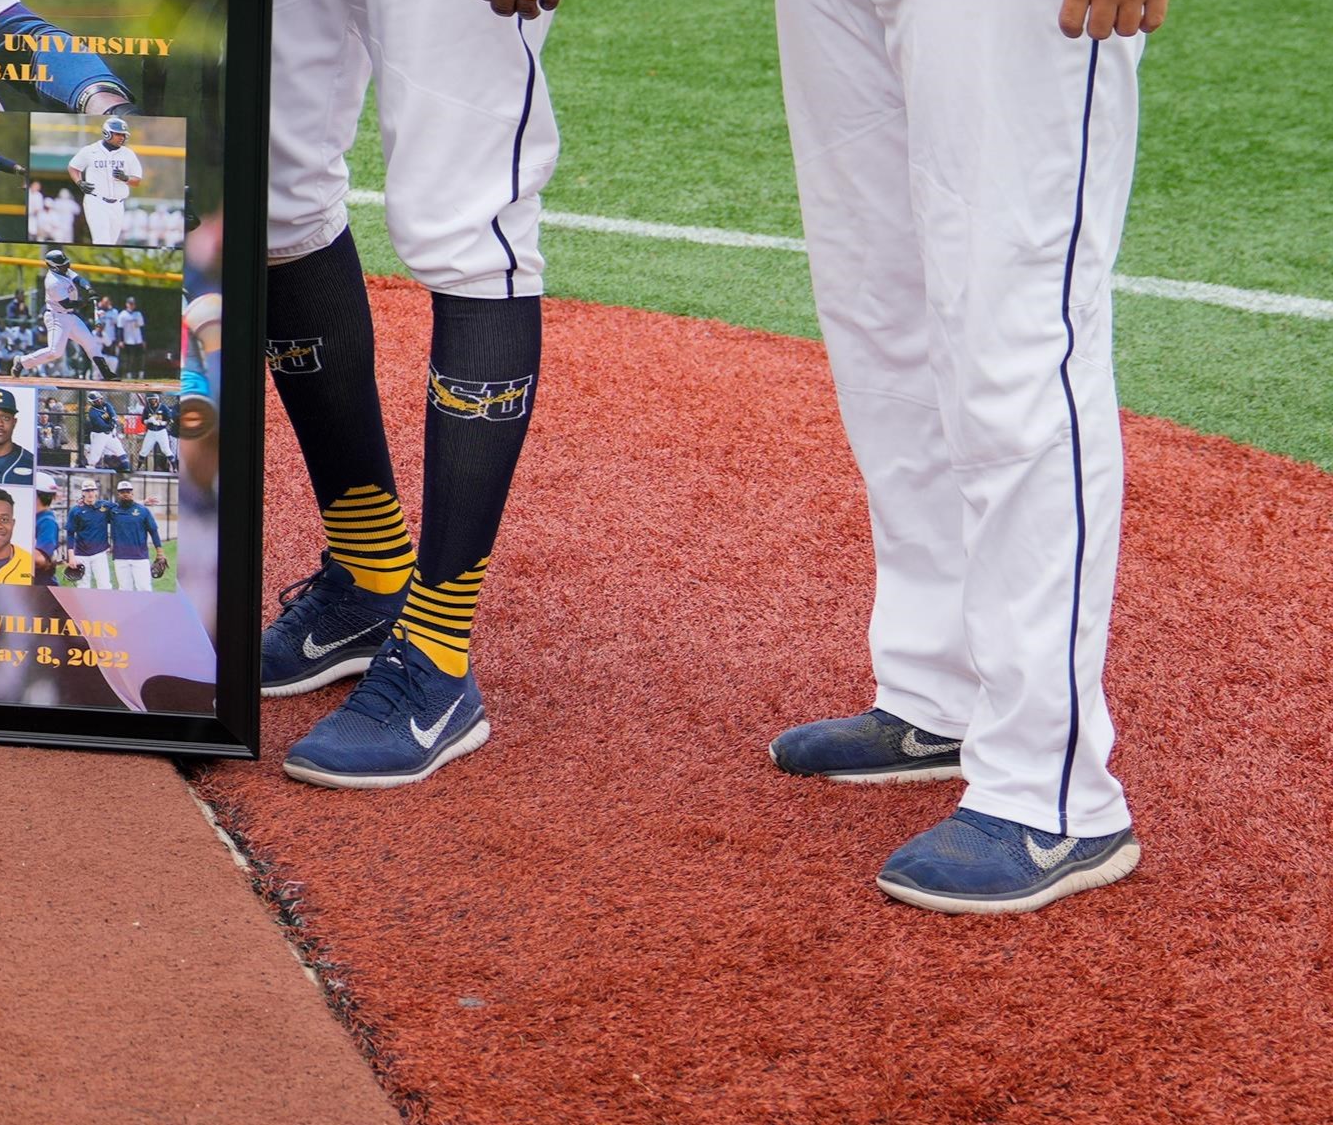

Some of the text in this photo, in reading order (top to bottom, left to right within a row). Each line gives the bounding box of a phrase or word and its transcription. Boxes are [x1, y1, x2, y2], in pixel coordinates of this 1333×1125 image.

[4, 33, 173, 56] UNIVERSITY
[36, 645, 60, 668] 8,
[67, 647, 130, 669] 2022
